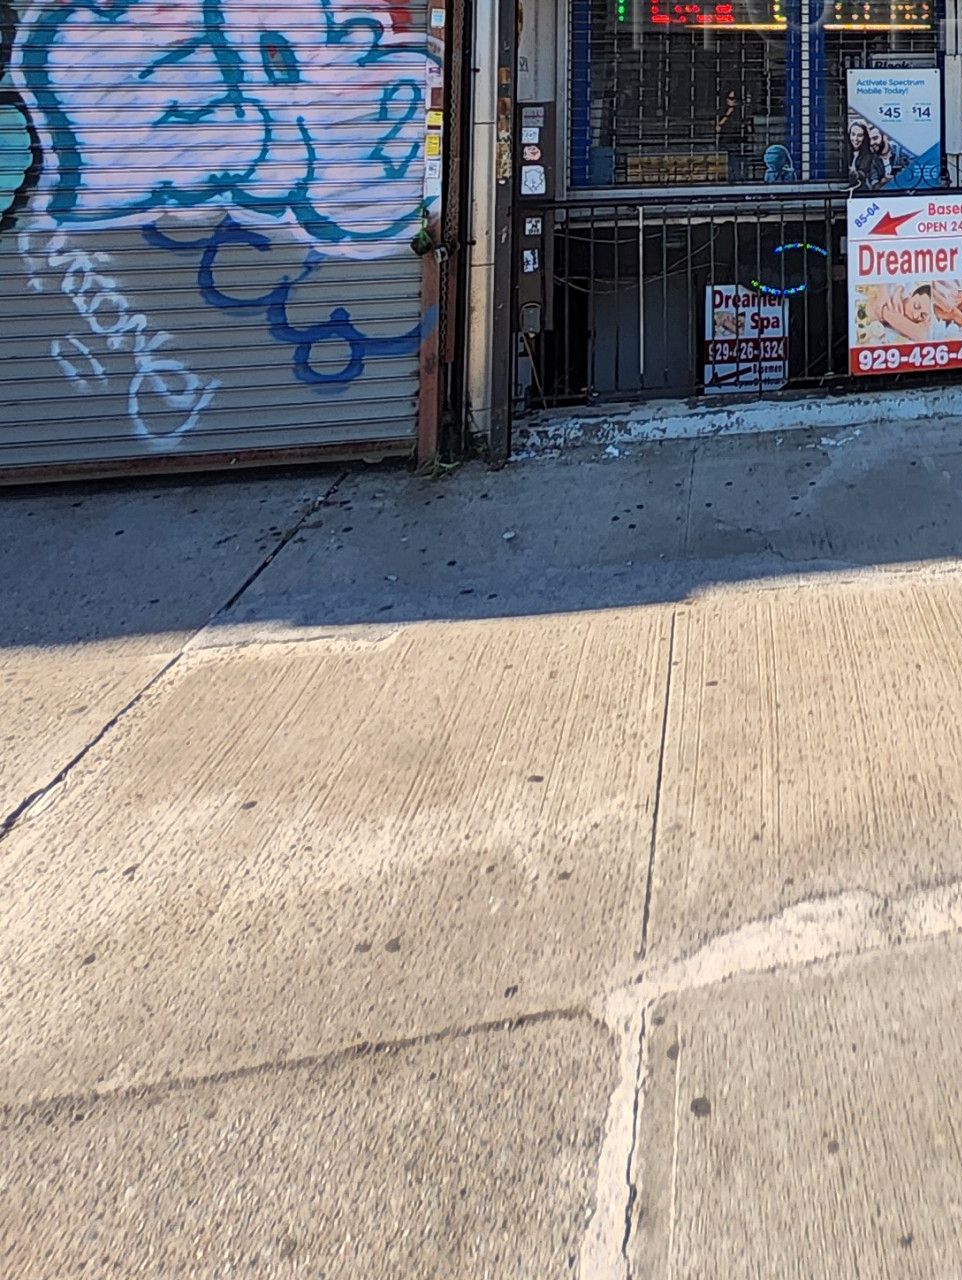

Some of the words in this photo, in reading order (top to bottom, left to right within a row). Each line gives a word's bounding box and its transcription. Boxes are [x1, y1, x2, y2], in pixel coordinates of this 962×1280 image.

[879, 106, 901, 119] $45
[912, 106, 931, 118] $14
[854, 202, 881, 228] 85-04
[917, 222, 947, 233] OPEN
[858, 243, 959, 276] Dreamer
[750, 312, 780, 335] Spa
